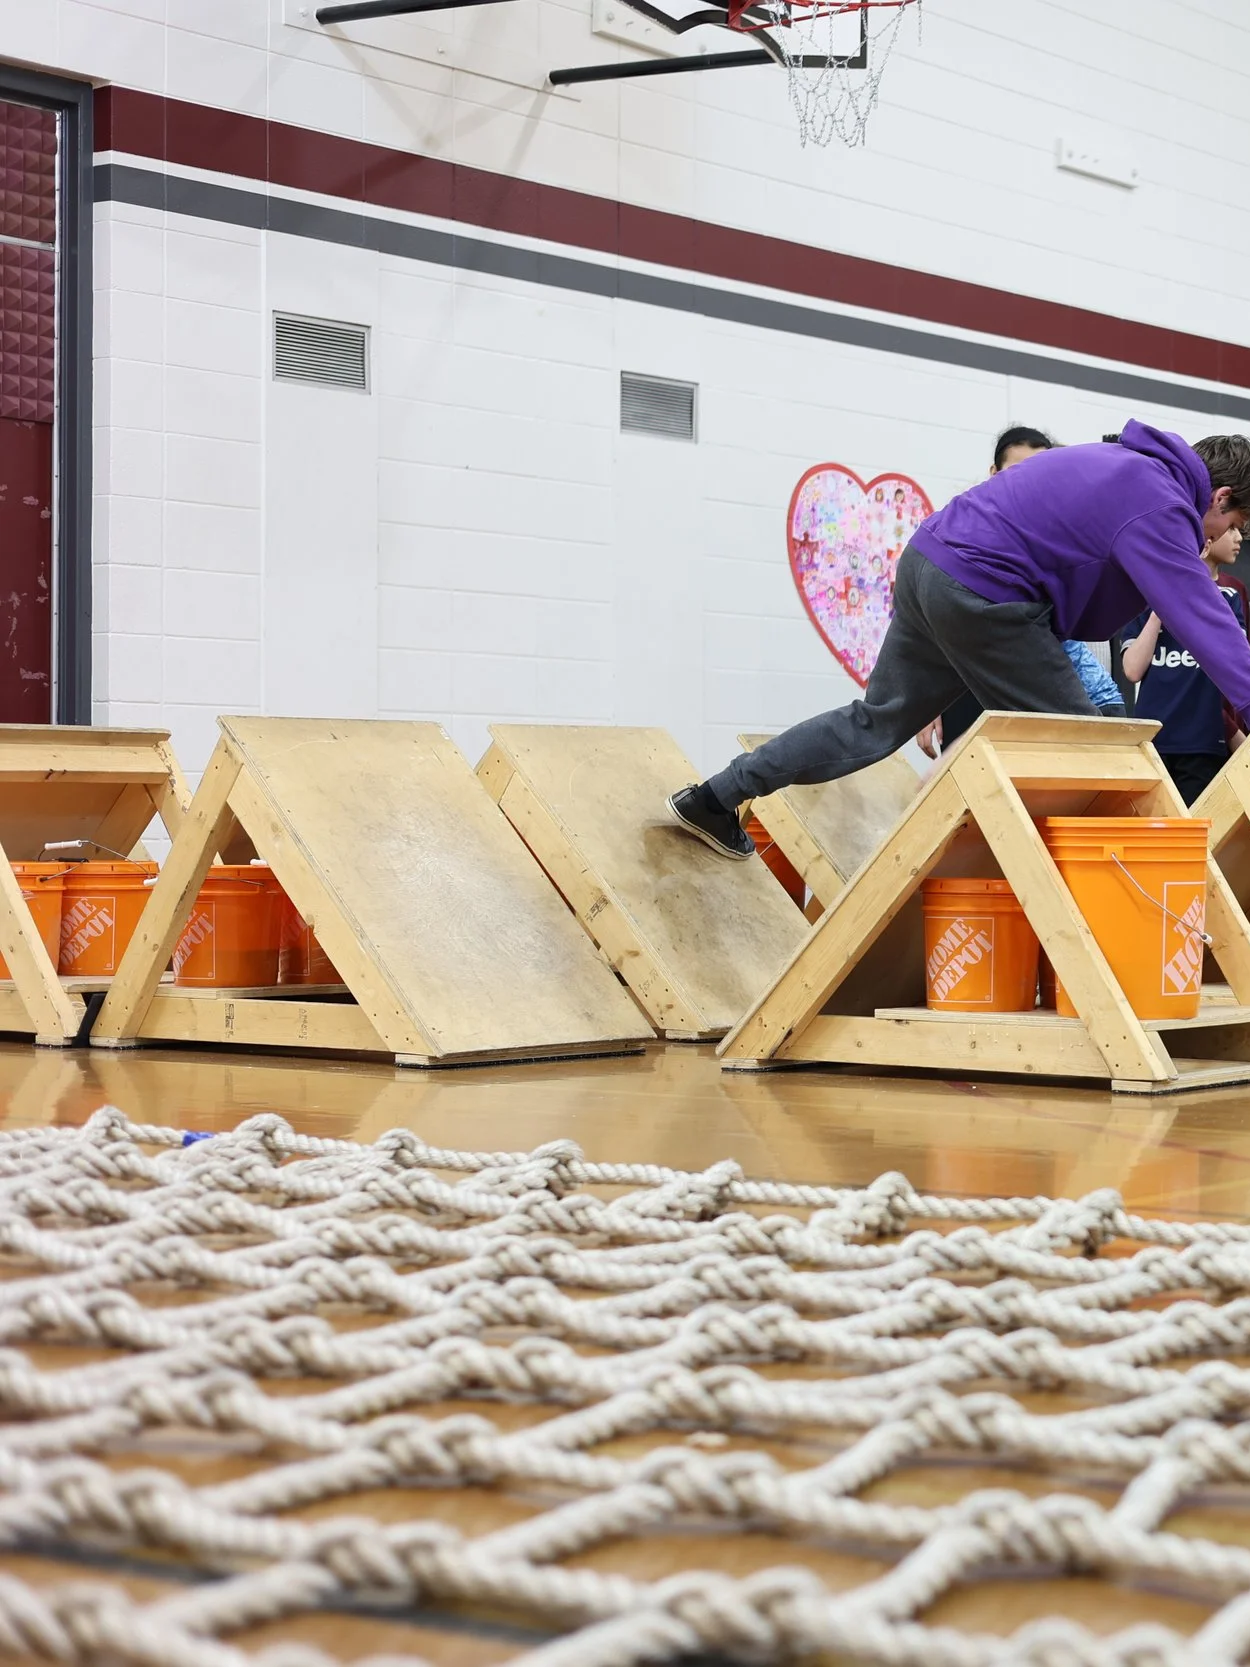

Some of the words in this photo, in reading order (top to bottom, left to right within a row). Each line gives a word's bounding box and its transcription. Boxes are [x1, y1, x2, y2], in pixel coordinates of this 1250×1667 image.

[1151, 646, 1200, 669] Jee
[60, 897, 97, 947] OME
[60, 907, 114, 966] DEPOT
[927, 917, 974, 981] HOME
[933, 930, 992, 1001] DEPOT
